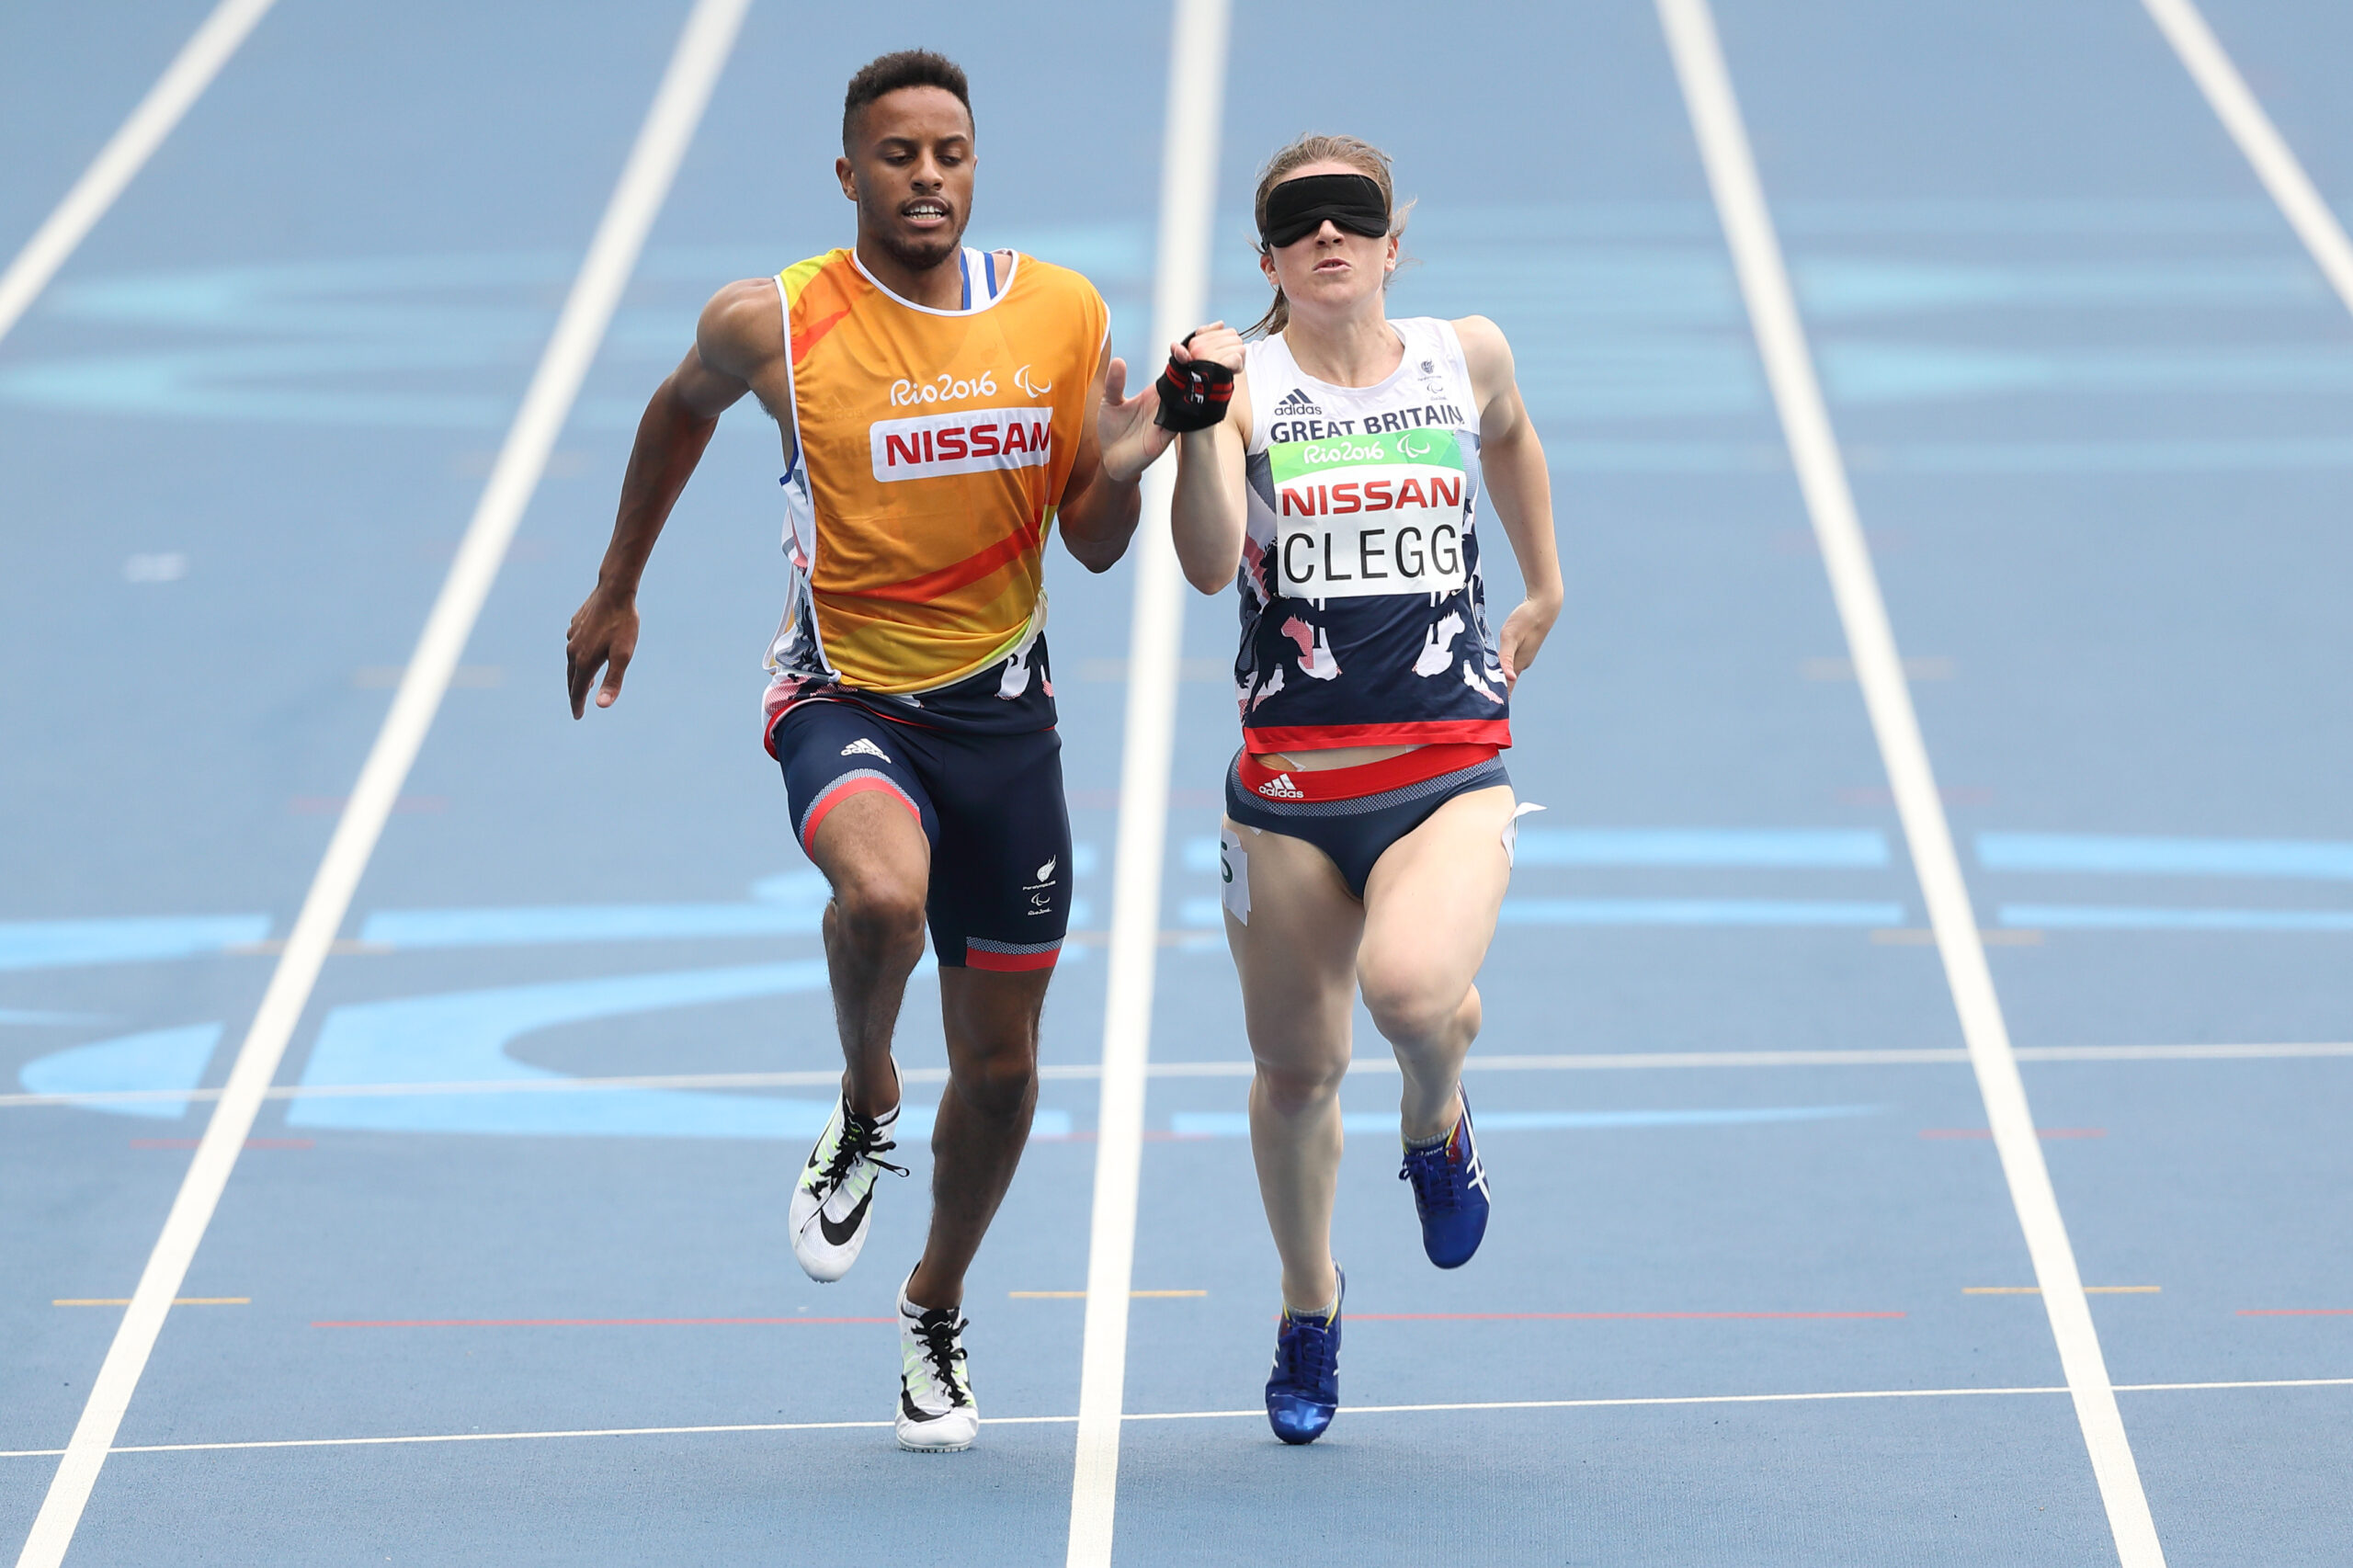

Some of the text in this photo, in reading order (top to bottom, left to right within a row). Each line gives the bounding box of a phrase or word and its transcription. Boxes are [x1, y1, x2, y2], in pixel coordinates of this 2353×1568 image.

[890, 369, 997, 406] Rio2016
[1270, 404, 1465, 444] GREAT BRITAIN
[1274, 403, 1322, 416] adidas
[885, 422, 1051, 467] NISSAN
[1302, 440, 1385, 464] Rio2016
[1281, 476, 1461, 517] NISSAN
[1283, 524, 1460, 584] CLEGG
[1258, 785, 1304, 799] adidas
